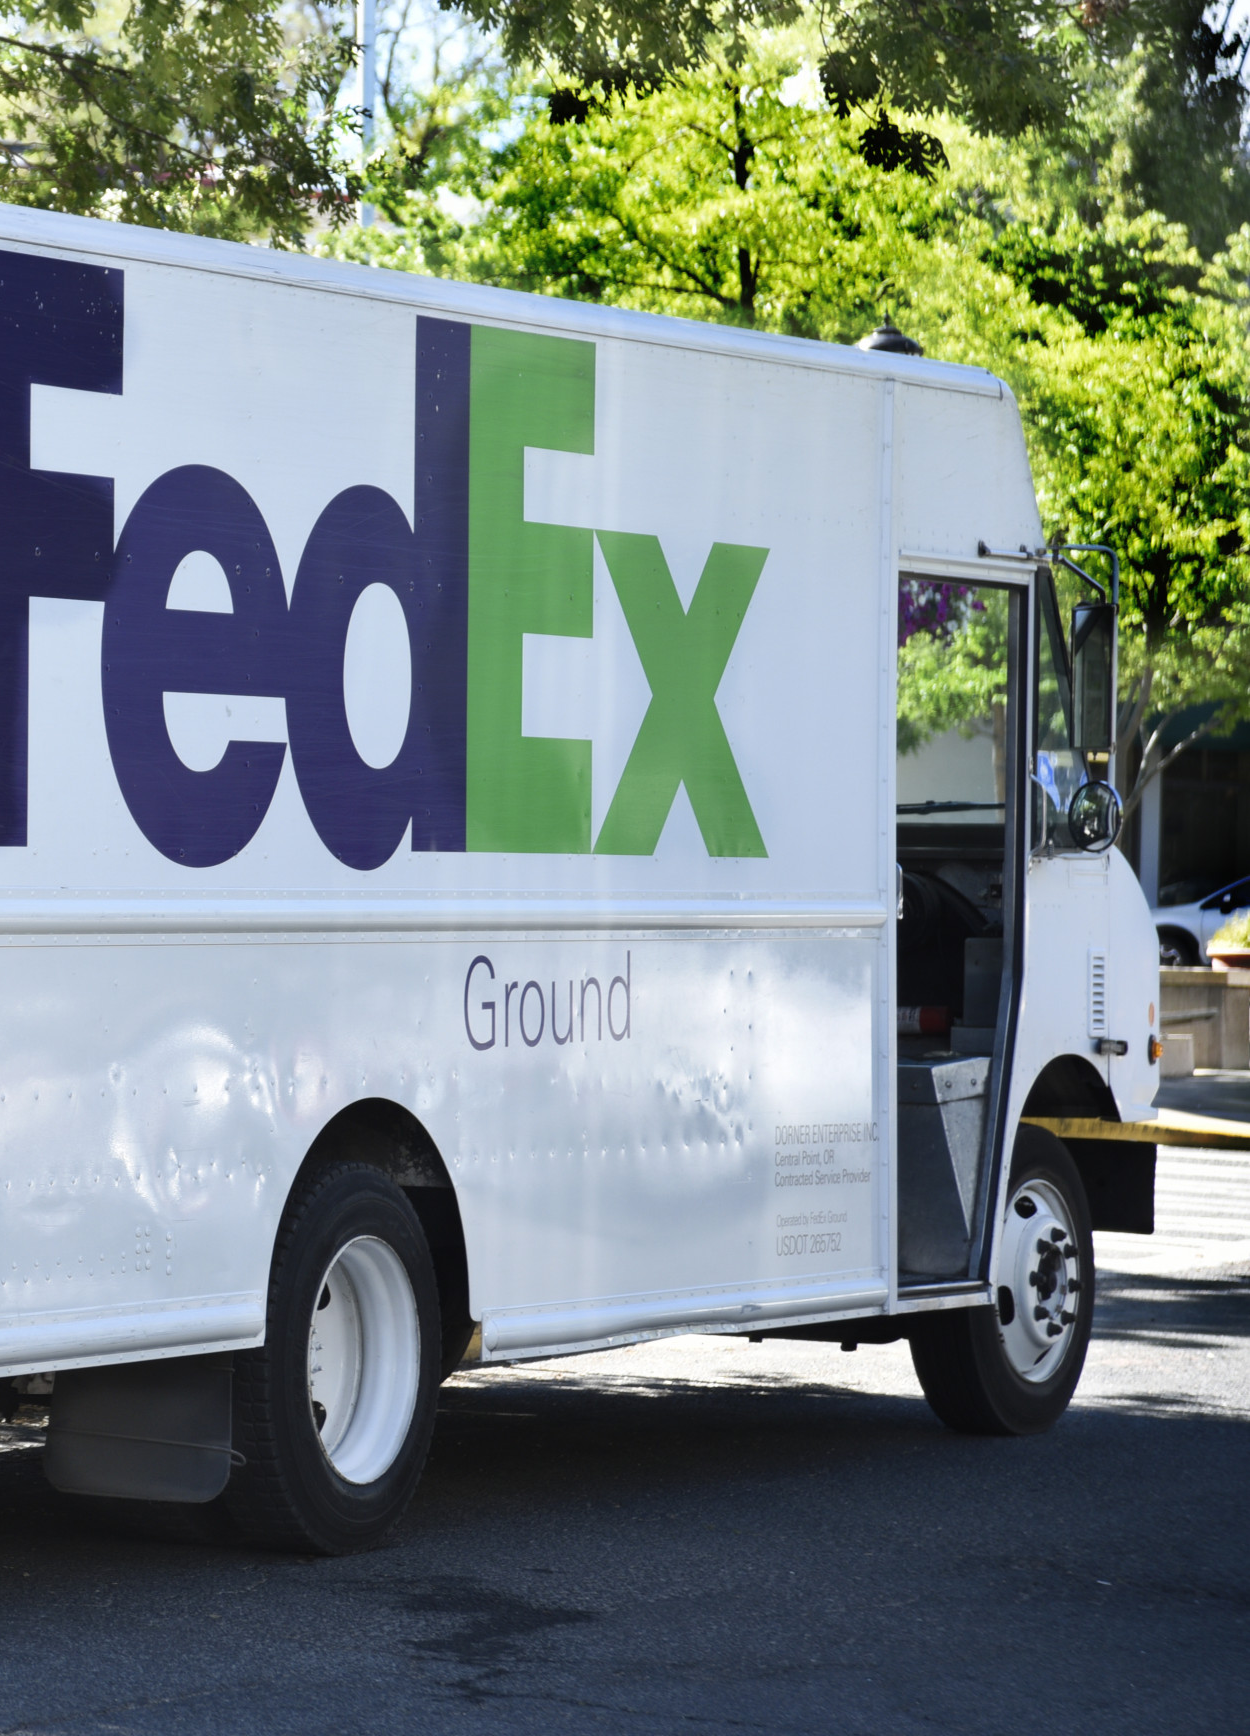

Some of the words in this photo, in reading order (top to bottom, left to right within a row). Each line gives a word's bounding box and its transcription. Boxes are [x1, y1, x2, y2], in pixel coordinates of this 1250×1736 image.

[464, 950, 631, 1051] Ground
[775, 1125, 810, 1145] DORNER
[812, 1123, 862, 1144] ENTERPRISE
[863, 1122, 880, 1142] INC.
[775, 1151, 800, 1167] Central
[802, 1150, 822, 1167] Point,
[823, 1149, 835, 1165] OR
[774, 1170, 814, 1187] Contracted
[815, 1169, 841, 1185] Service
[842, 1168, 871, 1184] Provider
[828, 1210, 848, 1224] Ground
[776, 1234, 809, 1256] USDOT
[810, 1232, 842, 1254] 265752
